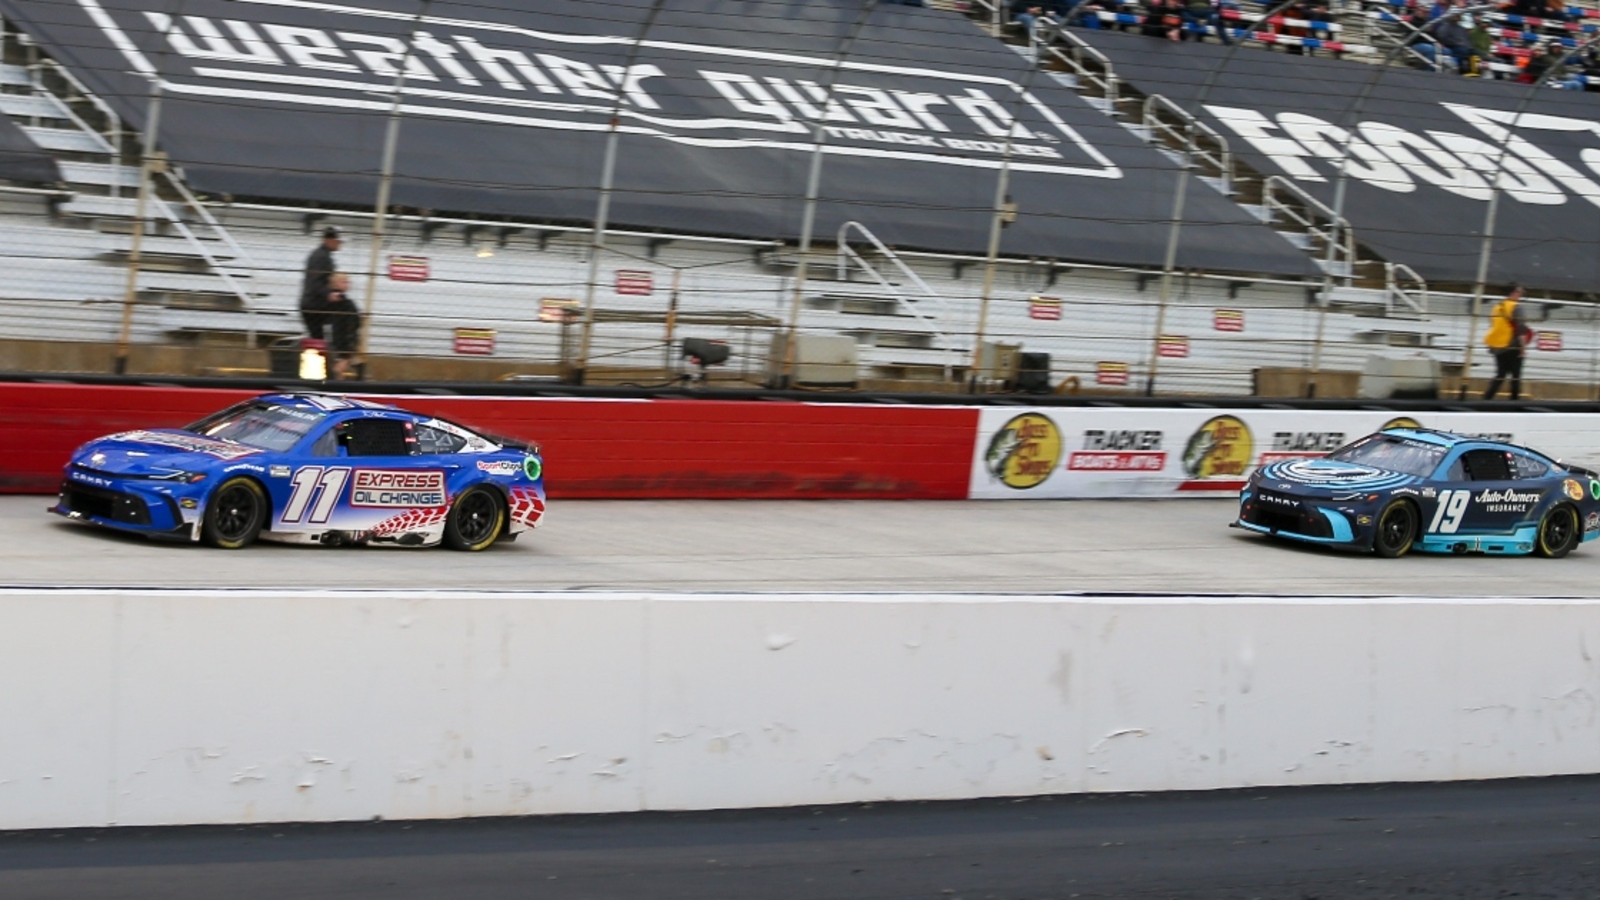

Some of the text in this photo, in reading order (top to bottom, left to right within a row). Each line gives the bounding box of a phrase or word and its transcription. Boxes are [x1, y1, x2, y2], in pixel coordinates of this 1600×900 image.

[824, 125, 1065, 159] TRUCK BOXES
[1202, 104, 1568, 205] FOOD
[1083, 429, 1163, 450] TRACKER
[1272, 432, 1345, 451] TRACKER
[1072, 455, 1118, 469] BOATS
[72, 471, 113, 487] CAMRY
[356, 473, 441, 488] EXPRESS
[278, 465, 352, 524] 11
[354, 491, 377, 503] OIL
[1259, 494, 1300, 507] CAMRY
[1475, 488, 1540, 503] Auto-Owners
[1428, 490, 1471, 533] 19
[1486, 503, 1526, 512] INSURANCE
